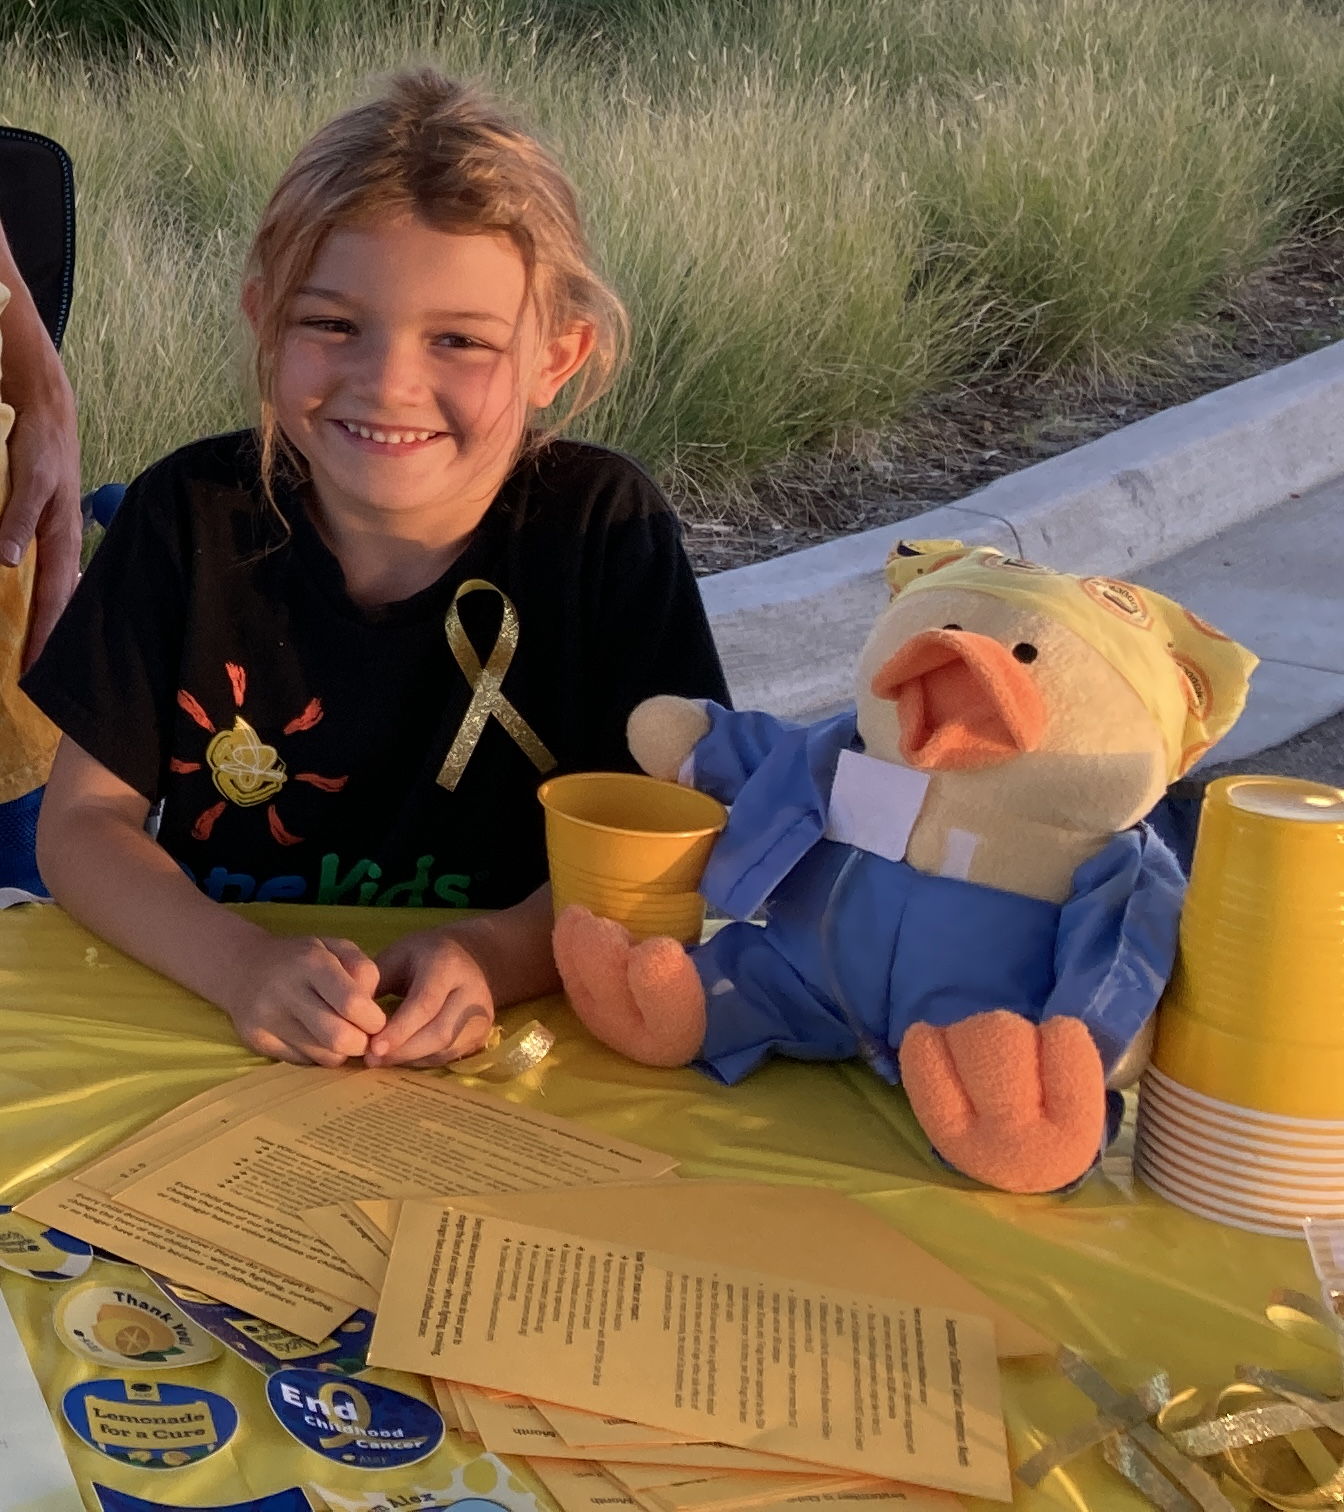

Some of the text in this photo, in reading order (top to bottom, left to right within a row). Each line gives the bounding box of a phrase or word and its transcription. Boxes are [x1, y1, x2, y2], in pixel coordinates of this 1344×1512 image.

[113, 1290, 174, 1324] Thank
[280, 1382, 358, 1422] End
[92, 1406, 205, 1425] Lemonade
[100, 1423, 207, 1441] for a Cure
[304, 1414, 405, 1438] Childhood
[513, 1428, 557, 1439] Month
[356, 1438, 423, 1450] Cancer
[386, 1493, 436, 1509] Alex
